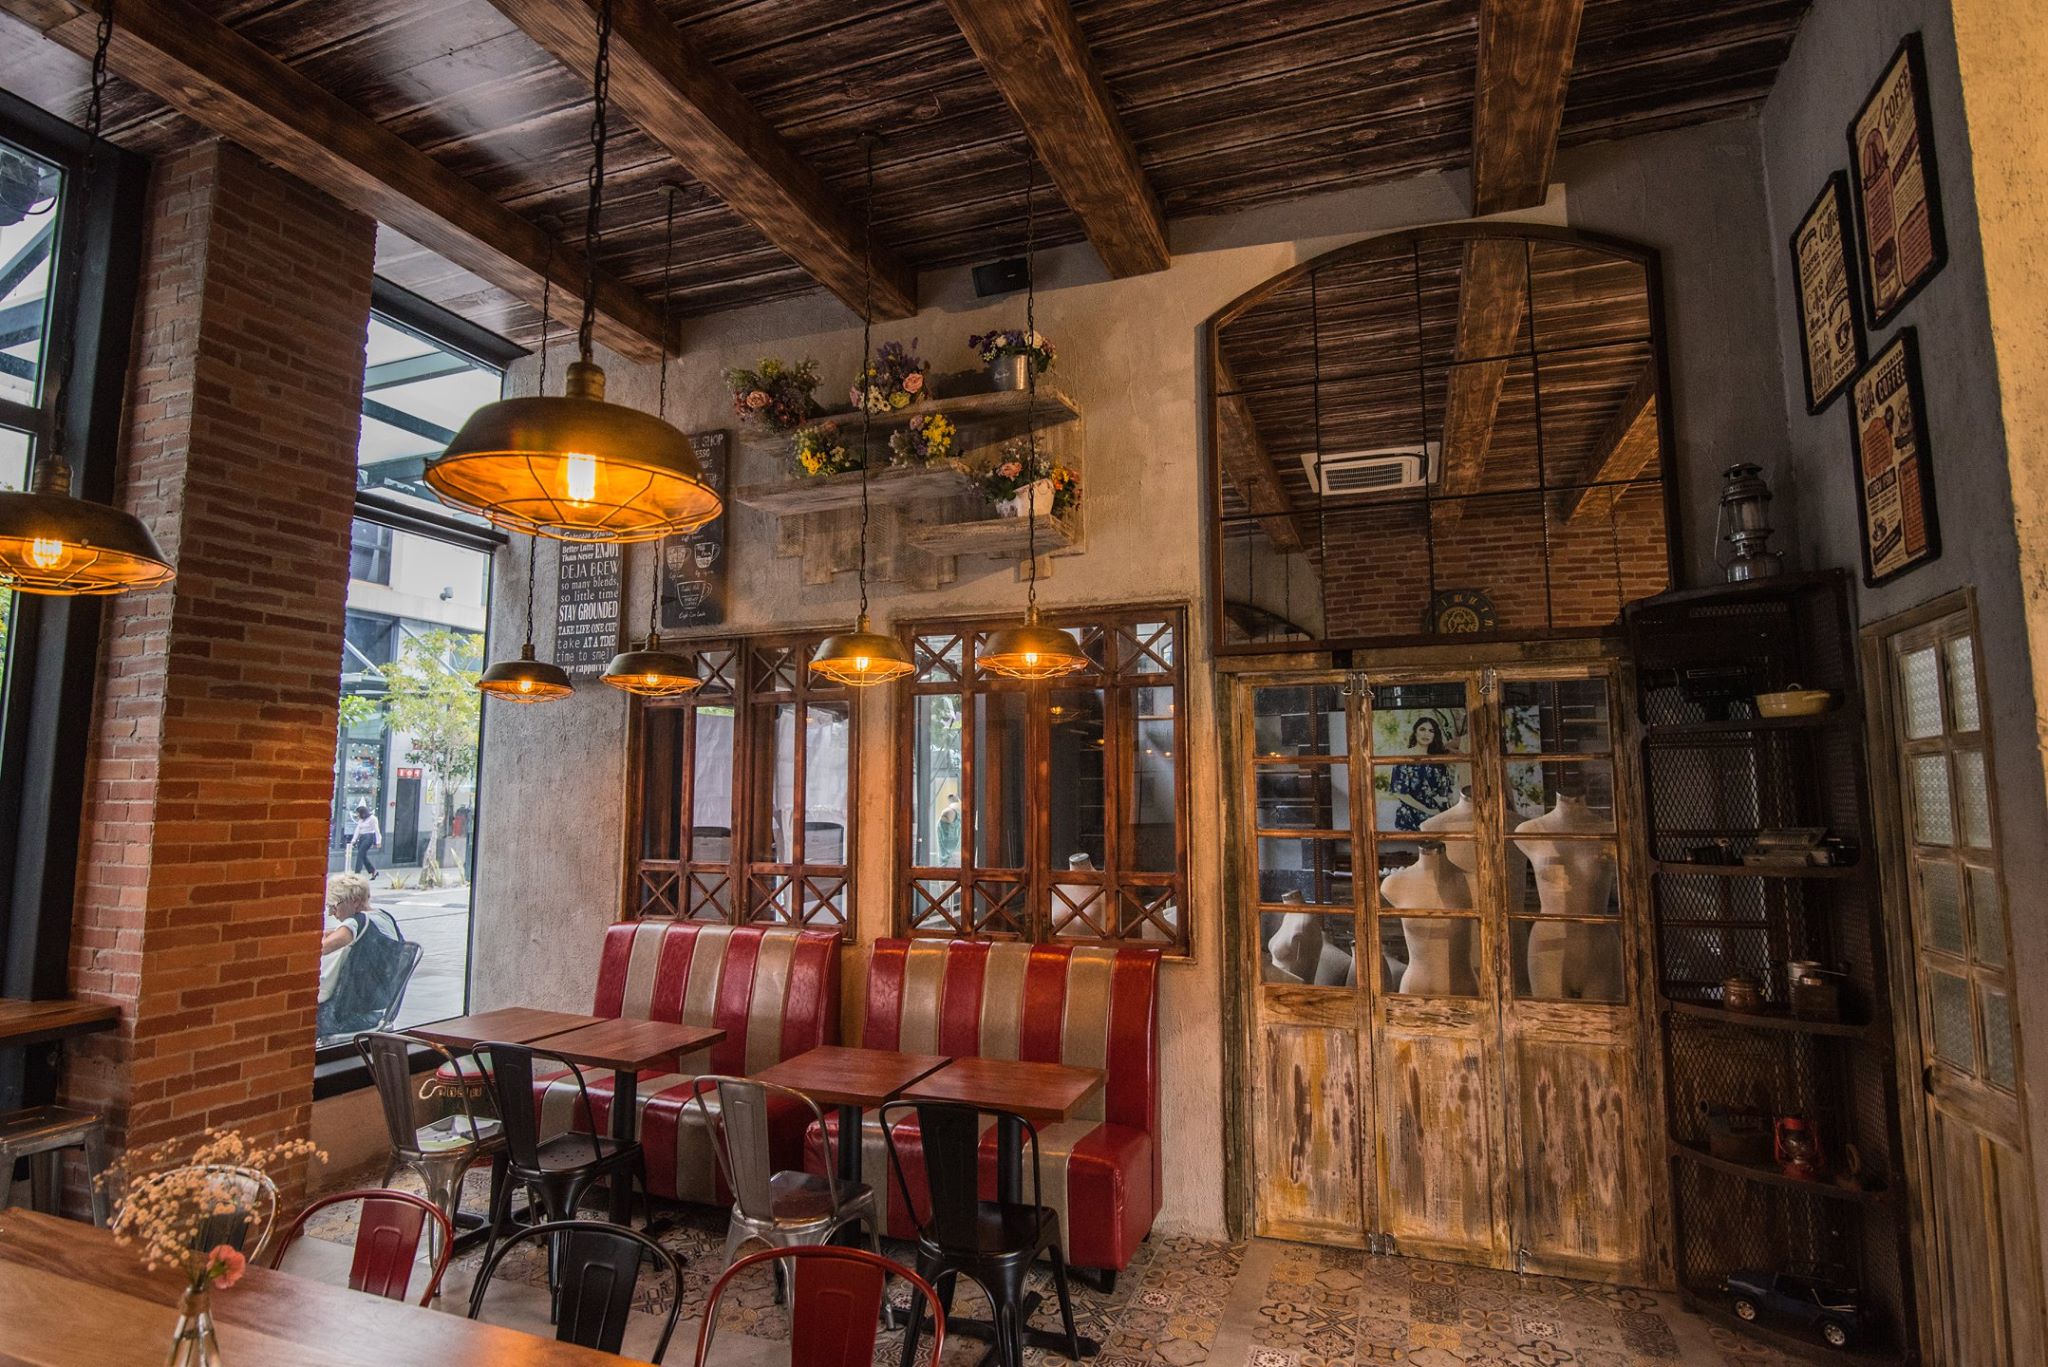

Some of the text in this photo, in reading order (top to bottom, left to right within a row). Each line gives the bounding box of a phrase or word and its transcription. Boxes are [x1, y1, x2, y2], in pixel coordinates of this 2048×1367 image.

[1877, 361, 1906, 401] COFFEE
[702, 433, 724, 447] SHOP
[562, 542, 620, 559] Better Latte ENJOY
[562, 552, 594, 562] Than Never
[561, 560, 620, 580] DEJA BREW
[561, 575, 619, 591] so many blends,
[560, 589, 619, 603] so little time
[558, 601, 618, 623] STAY GROUNDED
[558, 622, 617, 636] TAKE LIFE ONE CUP
[557, 638, 580, 650] take
[583, 636, 592, 648] AT
[599, 635, 616, 647] TIME
[556, 647, 614, 663] time to smell
